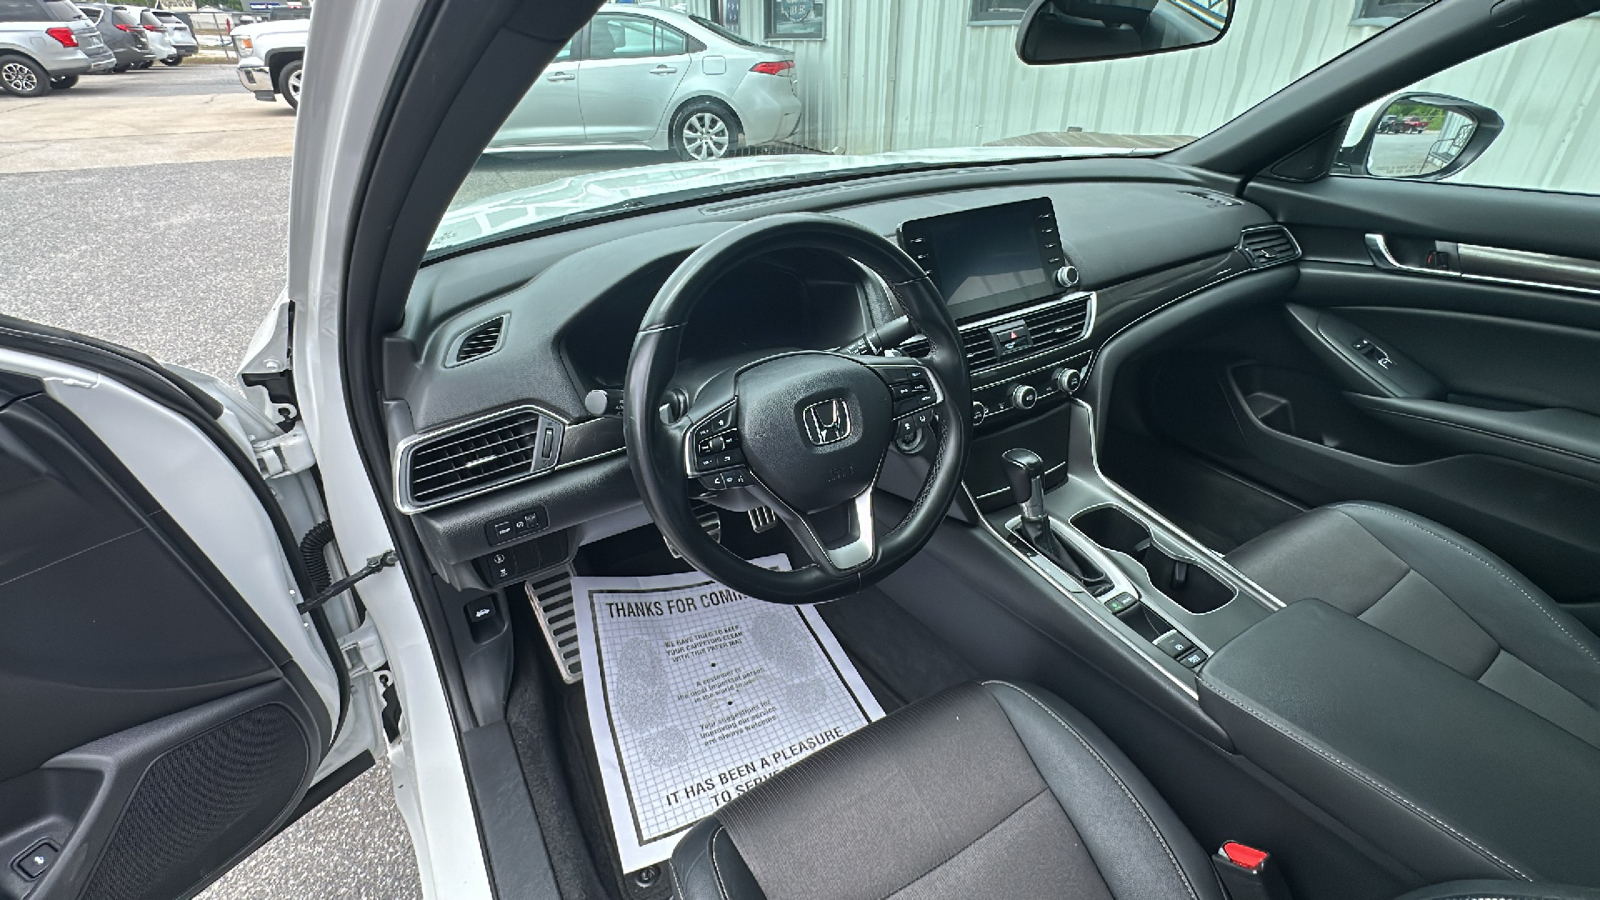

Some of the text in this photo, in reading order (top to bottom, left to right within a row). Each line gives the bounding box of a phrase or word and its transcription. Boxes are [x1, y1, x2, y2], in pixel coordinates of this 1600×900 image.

[606, 601, 664, 618] THANKS
[667, 597, 697, 615] FOR
[666, 646, 686, 656] YOUR
[722, 631, 743, 641] CLEAN
[676, 636, 694, 645] HAVE
[723, 625, 739, 633] KEEP
[672, 652, 691, 663] WITH
[700, 721, 716, 731] Your
[665, 727, 843, 806] IT HAS BEEN A PLEASURE
[709, 788, 733, 807] TO
